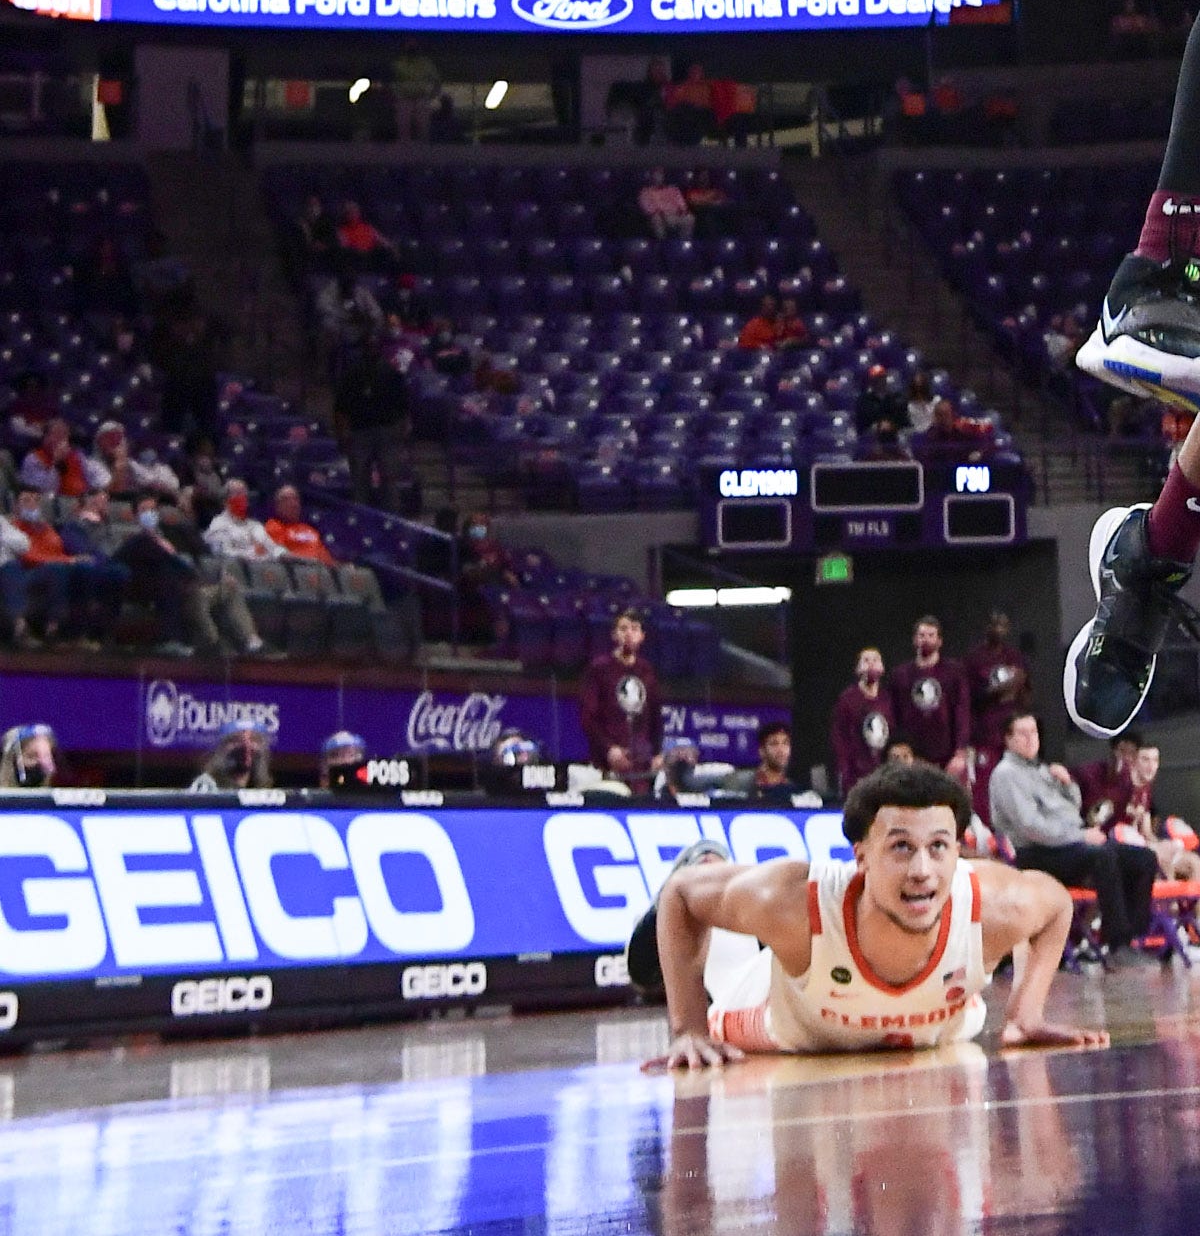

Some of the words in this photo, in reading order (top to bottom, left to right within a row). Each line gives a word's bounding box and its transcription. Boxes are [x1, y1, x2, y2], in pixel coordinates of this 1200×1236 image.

[367, 759, 410, 786] POSS
[0, 811, 475, 974] GEICO
[171, 976, 273, 1016] GEICO
[402, 961, 487, 1000] GEICO
